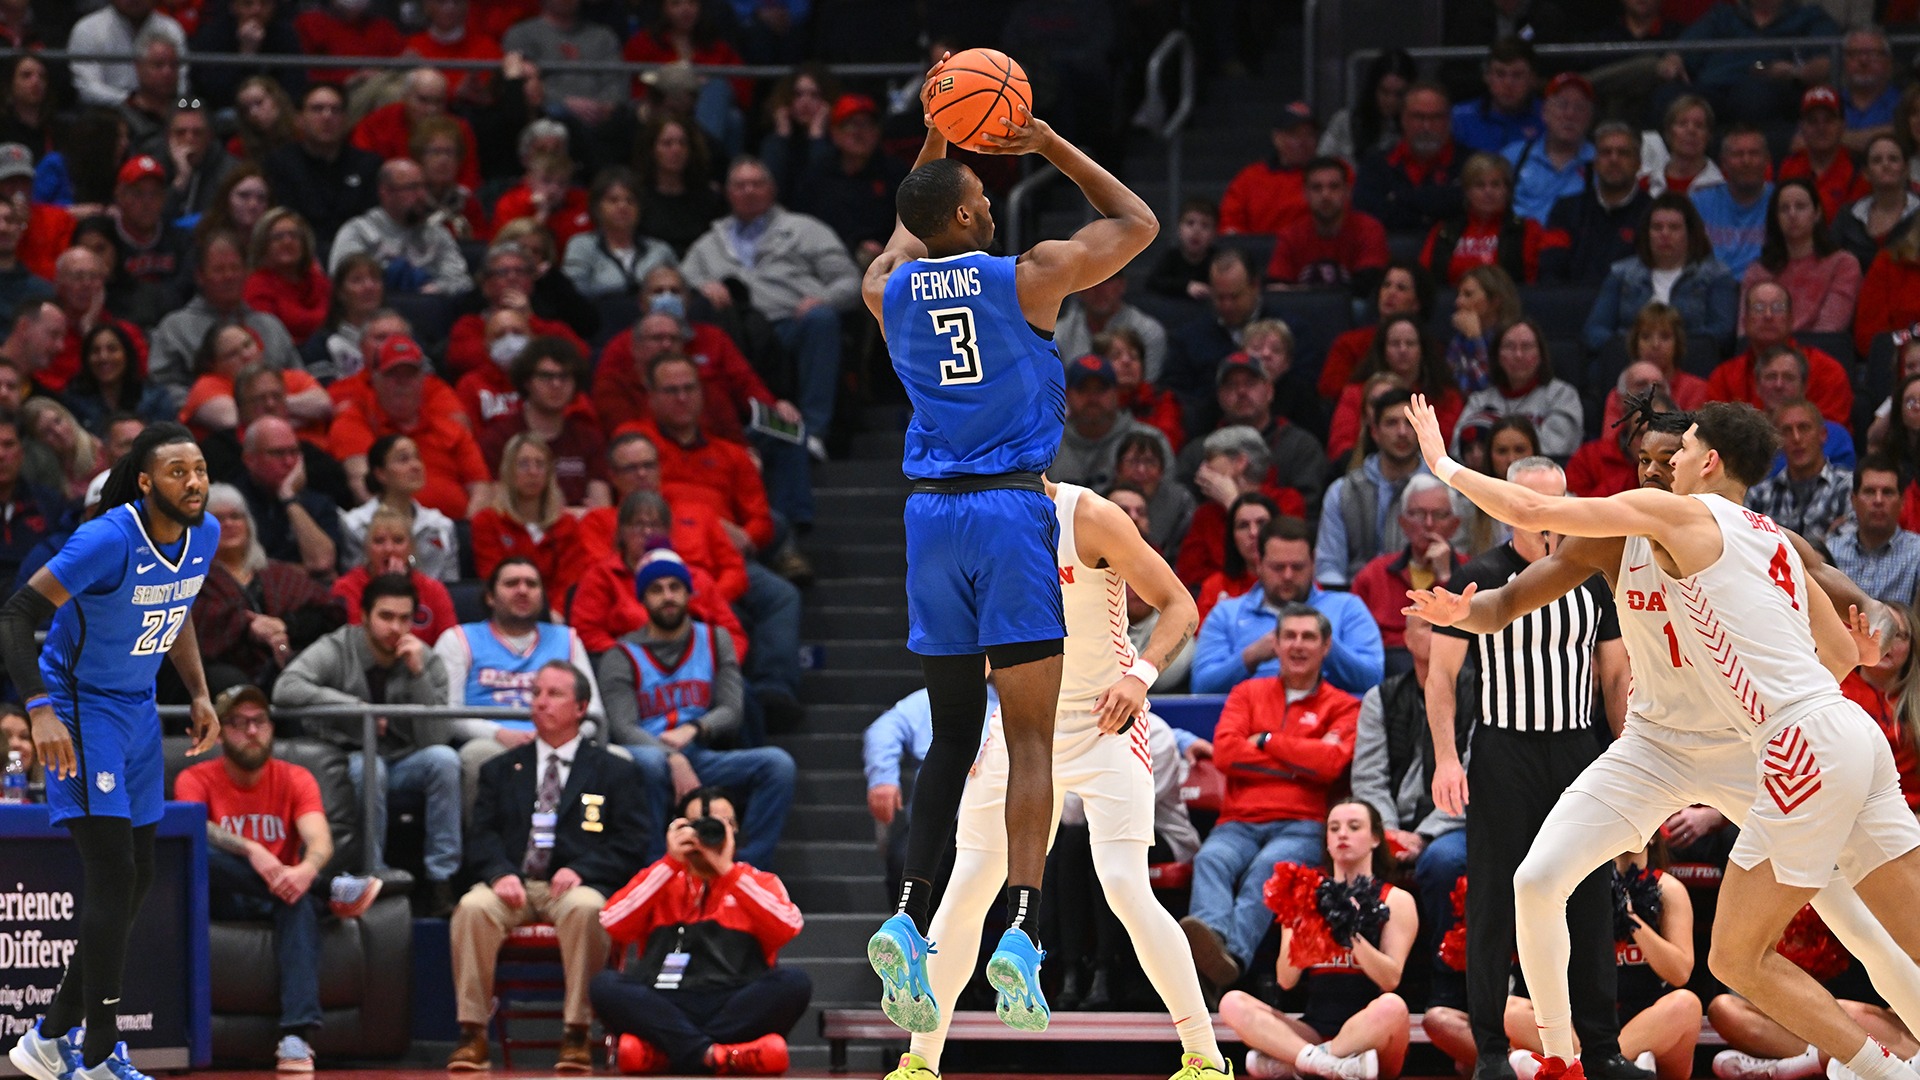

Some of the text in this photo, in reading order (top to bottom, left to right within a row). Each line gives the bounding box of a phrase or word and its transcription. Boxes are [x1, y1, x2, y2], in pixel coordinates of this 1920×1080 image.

[910, 267, 982, 301] PERKINS
[927, 306, 984, 386] 3
[131, 583, 175, 605] SAINT
[1768, 543, 1800, 611] 4
[130, 605, 188, 656] 22
[0, 929, 78, 969] Differe
